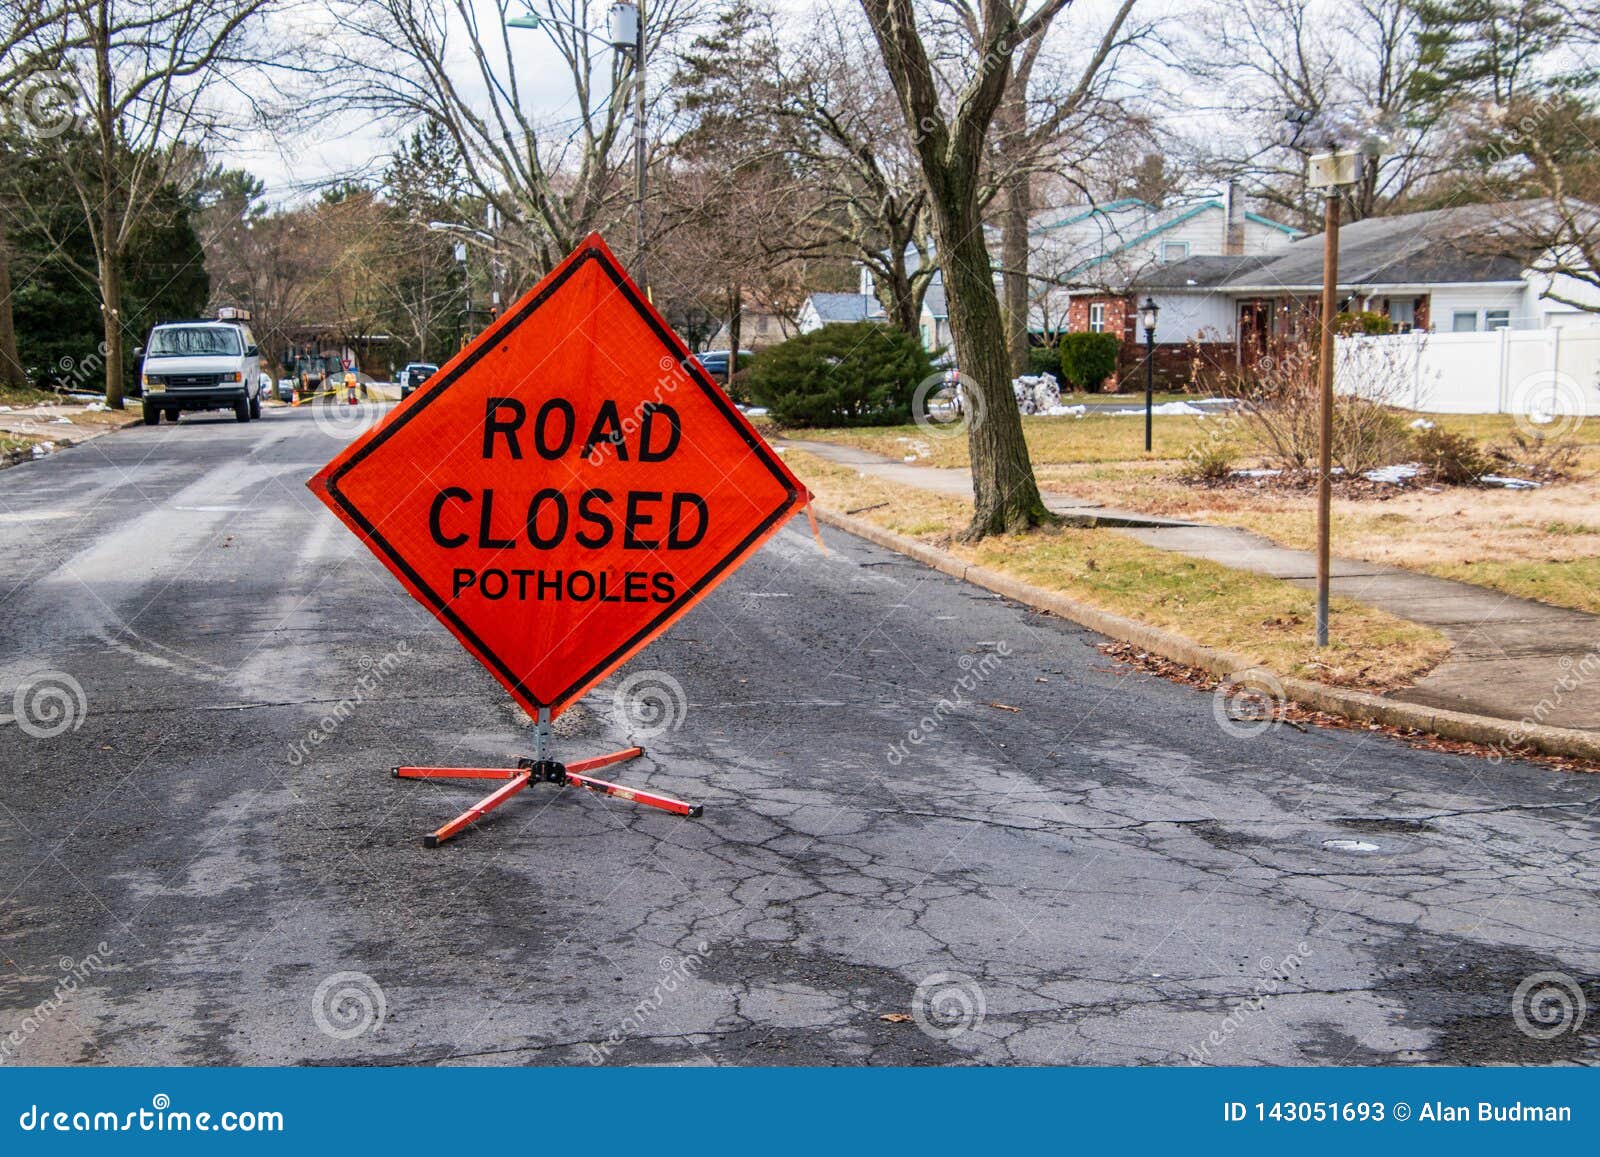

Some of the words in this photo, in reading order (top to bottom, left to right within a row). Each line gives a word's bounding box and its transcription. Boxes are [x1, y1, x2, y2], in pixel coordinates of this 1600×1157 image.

[482, 397, 682, 462] ROAD
[429, 487, 709, 551] CLOSED
[453, 568, 676, 604] POTHOLES
